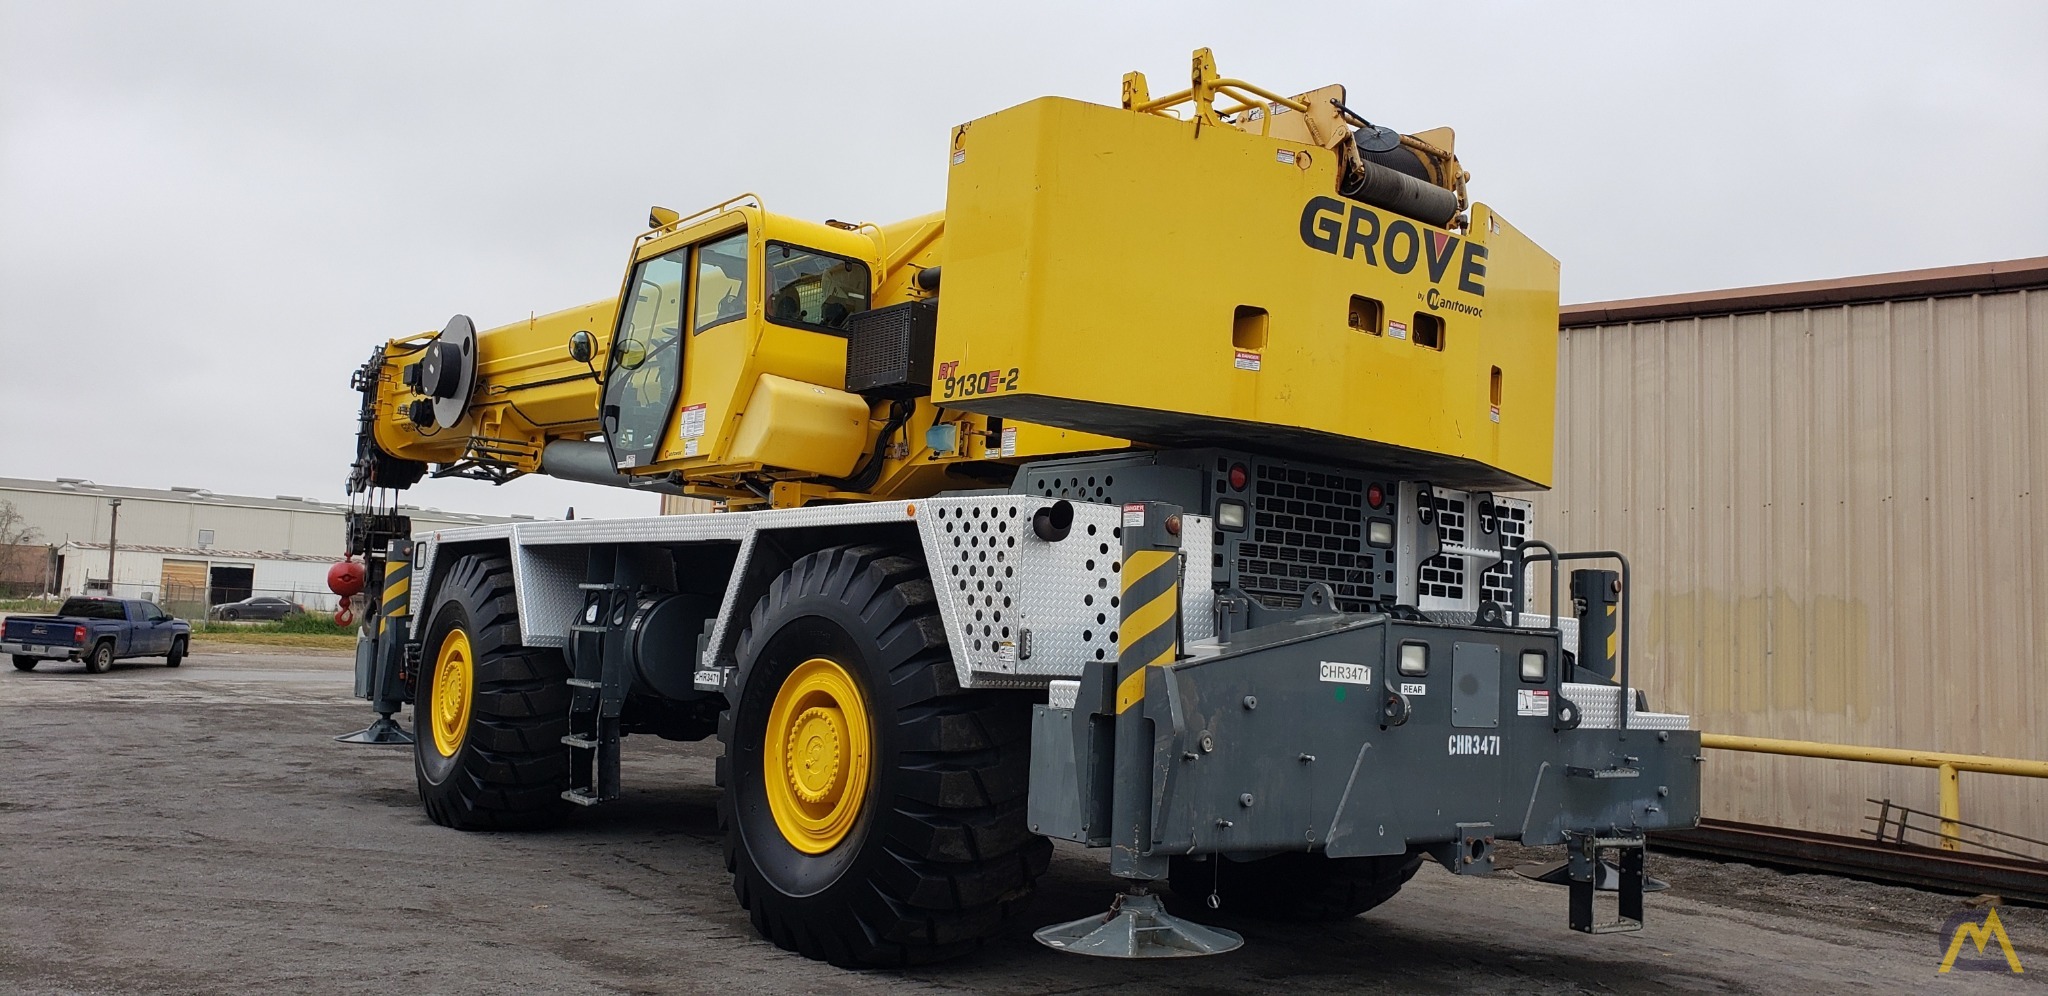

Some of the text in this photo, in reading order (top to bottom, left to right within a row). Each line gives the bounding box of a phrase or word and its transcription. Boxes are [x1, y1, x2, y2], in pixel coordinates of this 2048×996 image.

[1300, 196, 1488, 297] GROVE
[1417, 288, 1483, 318] by Manitowoc
[938, 361, 959, 380] RT
[944, 367, 1019, 399] 9130E-2
[1321, 665, 1369, 681] CHR3471
[1403, 684, 1423, 694] REAR
[1448, 734, 1500, 756] CHR3471
